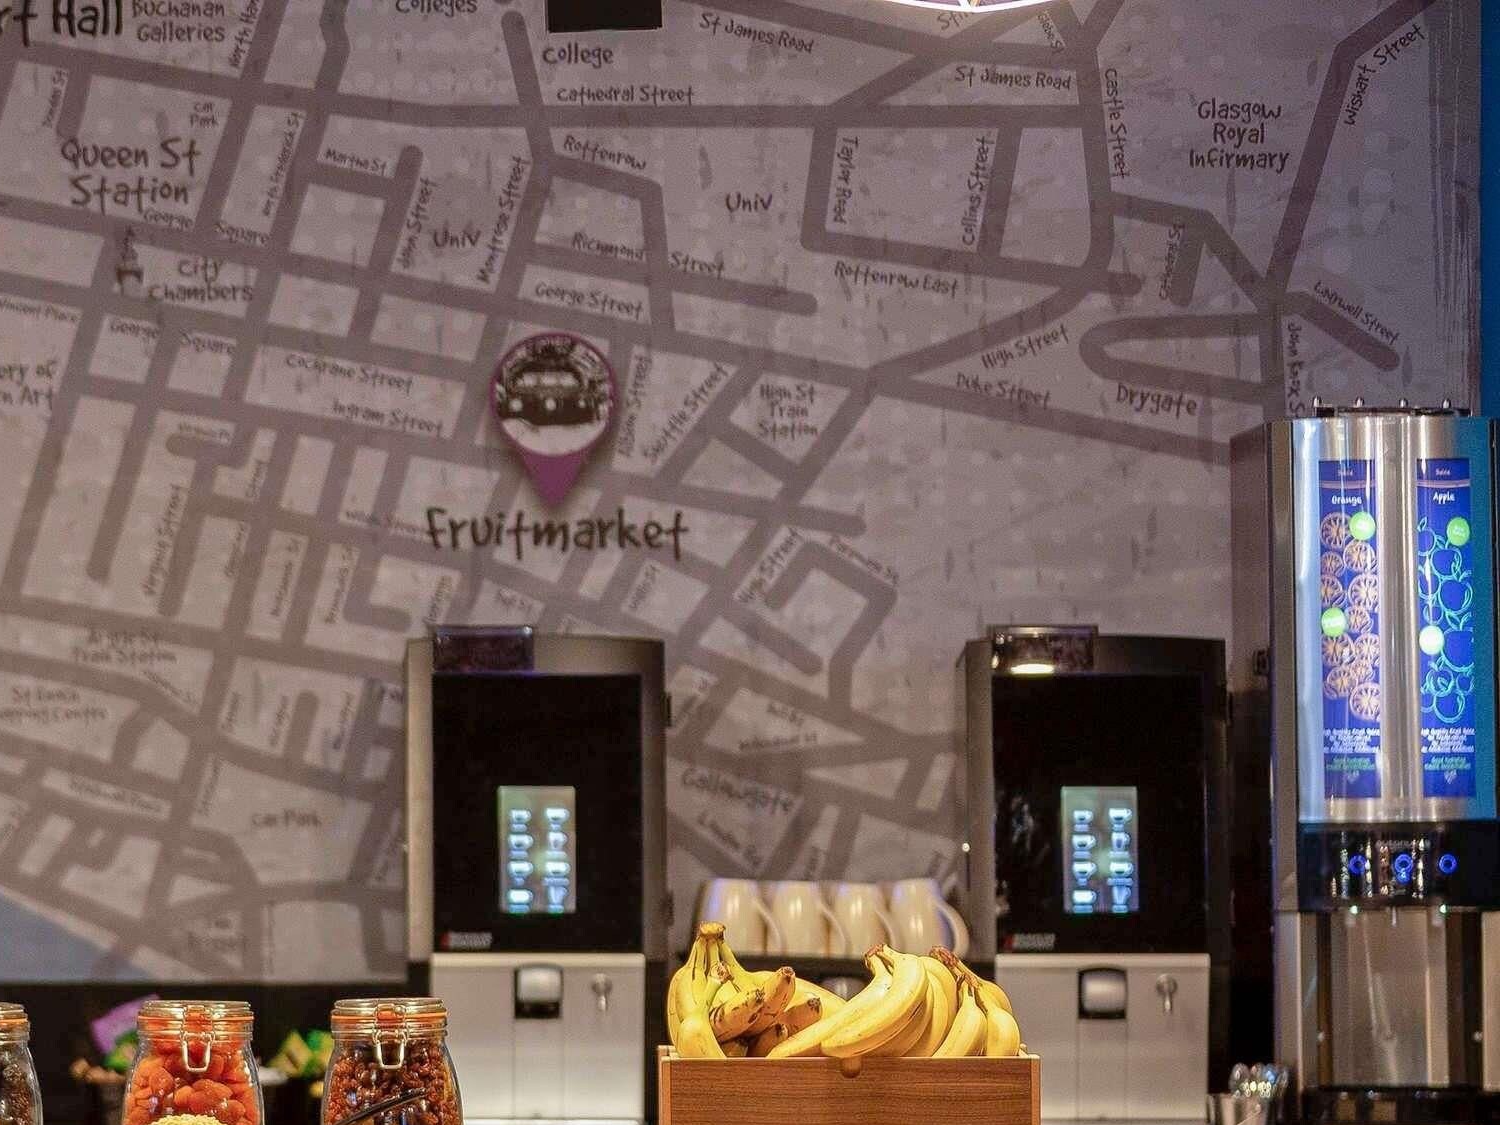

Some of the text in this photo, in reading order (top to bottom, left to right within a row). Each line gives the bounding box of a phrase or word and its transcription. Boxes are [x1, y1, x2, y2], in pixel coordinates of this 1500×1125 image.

[52, 0, 123, 37] Hall
[132, 0, 225, 19] Buchanan
[396, 0, 478, 17] Colleges
[137, 23, 225, 43] Galleries
[700, 12, 814, 54] St James Road
[542, 43, 614, 69] College
[954, 65, 1072, 90] St James Road
[1344, 23, 1425, 126] Wishart Street
[557, 85, 695, 107] Cathedral Street
[1104, 67, 1130, 180] Castle Street
[1197, 99, 1282, 122] Glasgow
[1212, 123, 1266, 144] Royal
[60, 137, 201, 178] Queen St
[563, 135, 647, 171] Rottenrow
[836, 135, 860, 185] Taylor
[1189, 147, 1290, 174] Infirmary
[69, 175, 190, 215] Station
[499, 155, 531, 214] Street
[961, 135, 996, 246] Collins Street
[406, 176, 438, 232] Street
[724, 192, 773, 214] Univ
[432, 228, 482, 250] Univ
[177, 257, 224, 283] City
[669, 252, 726, 278] Street
[834, 259, 959, 298] Rottenrow East
[148, 284, 254, 305] Chambers
[535, 283, 644, 321] George Street
[981, 324, 1070, 370] High Street
[357, 366, 414, 394] Street
[759, 384, 816, 404] High St
[956, 372, 1051, 410] Duke Street
[1116, 383, 1198, 419] Drygate
[389, 408, 443, 436] Street
[1332, 495, 1362, 507] Orange
[1433, 491, 1455, 505] Apple
[425, 505, 690, 561] Fruitmarket
